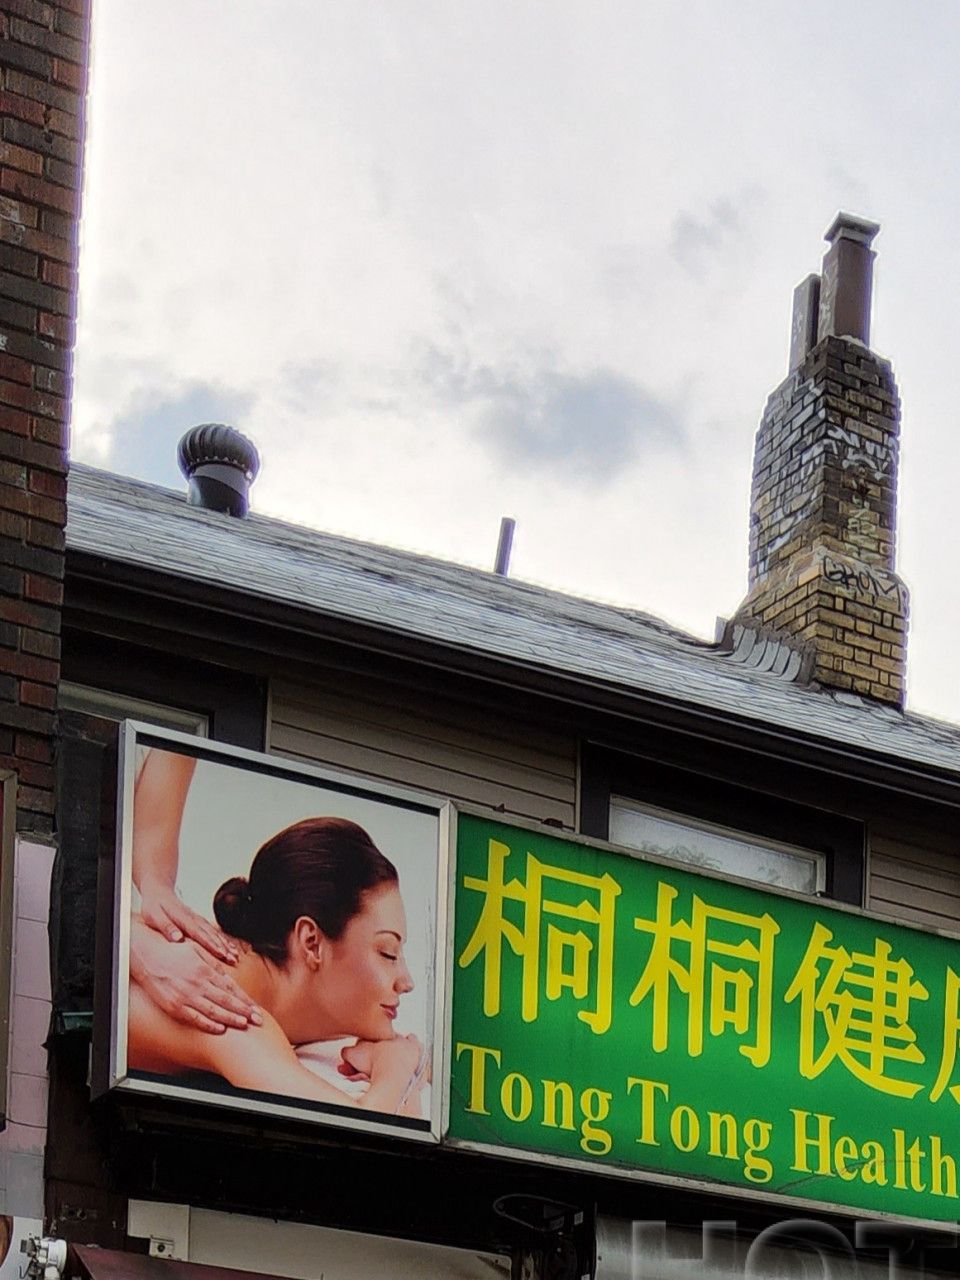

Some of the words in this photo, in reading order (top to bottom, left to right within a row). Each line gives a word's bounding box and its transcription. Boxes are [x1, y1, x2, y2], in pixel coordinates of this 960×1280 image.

[456, 1042, 613, 1155] Tong
[627, 1076, 773, 1183] Tong
[788, 1108, 959, 1199] Health
